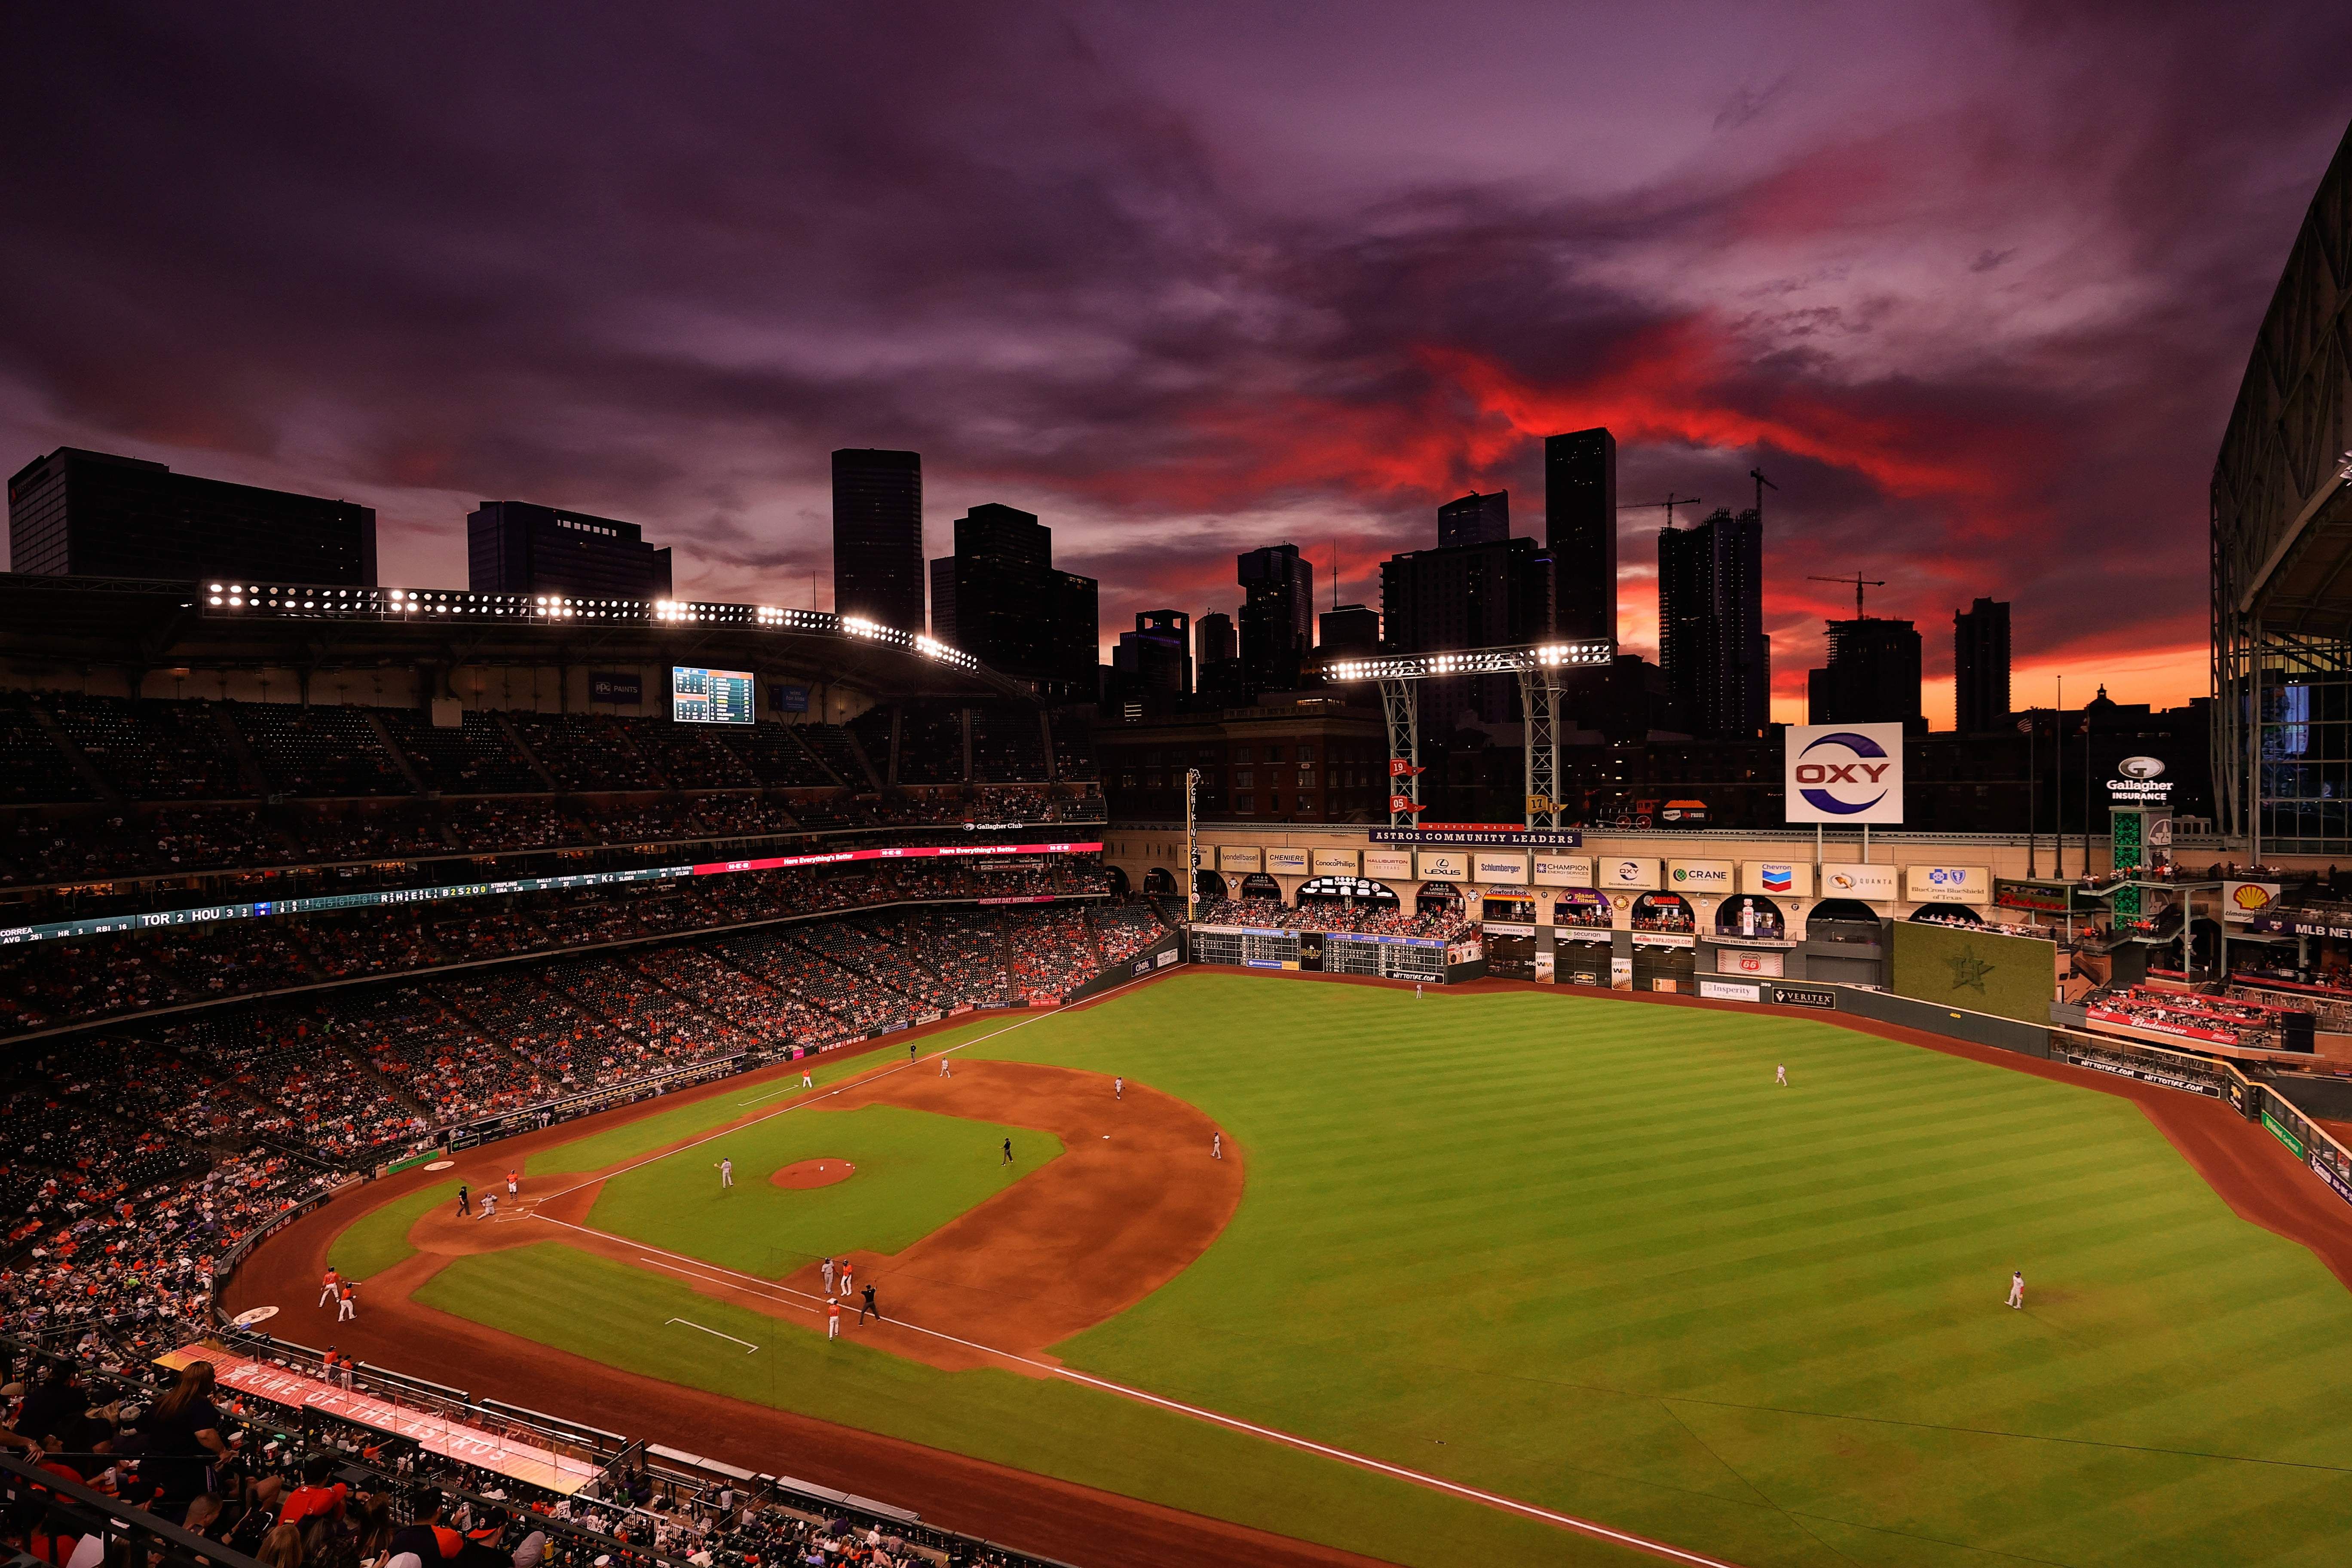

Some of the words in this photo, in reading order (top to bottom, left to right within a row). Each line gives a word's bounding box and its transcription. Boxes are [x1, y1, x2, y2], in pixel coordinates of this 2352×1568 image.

[1394, 763, 1403, 772] 19
[1796, 763, 1891, 784] OXY
[2106, 780, 2174, 792] Gallagher
[1393, 799, 1403, 808] 05
[1531, 799, 1543, 808] 17
[1426, 833, 1506, 842] COMMUNITY
[1512, 835, 1573, 843] LEADERS
[799, 856, 835, 864] Everything's
[1315, 860, 1356, 868] ConocoPhillips
[1481, 864, 1521, 873] Schlumberger
[1689, 870, 1727, 879] CRANE
[142, 913, 170, 926] TOR
[177, 913, 184, 922] 2
[192, 909, 220, 921] HOU
[226, 908, 233, 917] 3
[0, 927, 33, 937] CORREA
[2295, 924, 2326, 936] MLB
[3, 936, 21, 944] AVG
[1301, 948, 1322, 956] RALLY
[1743, 961, 1757, 969] 66
[1393, 971, 1436, 983] NITTOTIRE.COM
[1713, 985, 1751, 995] Insperity
[1787, 992, 1831, 1003] VERITEX
[2129, 1016, 2187, 1034] Budweiser
[2081, 1060, 2134, 1077] NITTOTIRE.COM
[2144, 1073, 2203, 1093] NITTOTIRE.COM
[399, 1421, 511, 1461] ASTROS
[559, 1507, 569, 1516] 27
